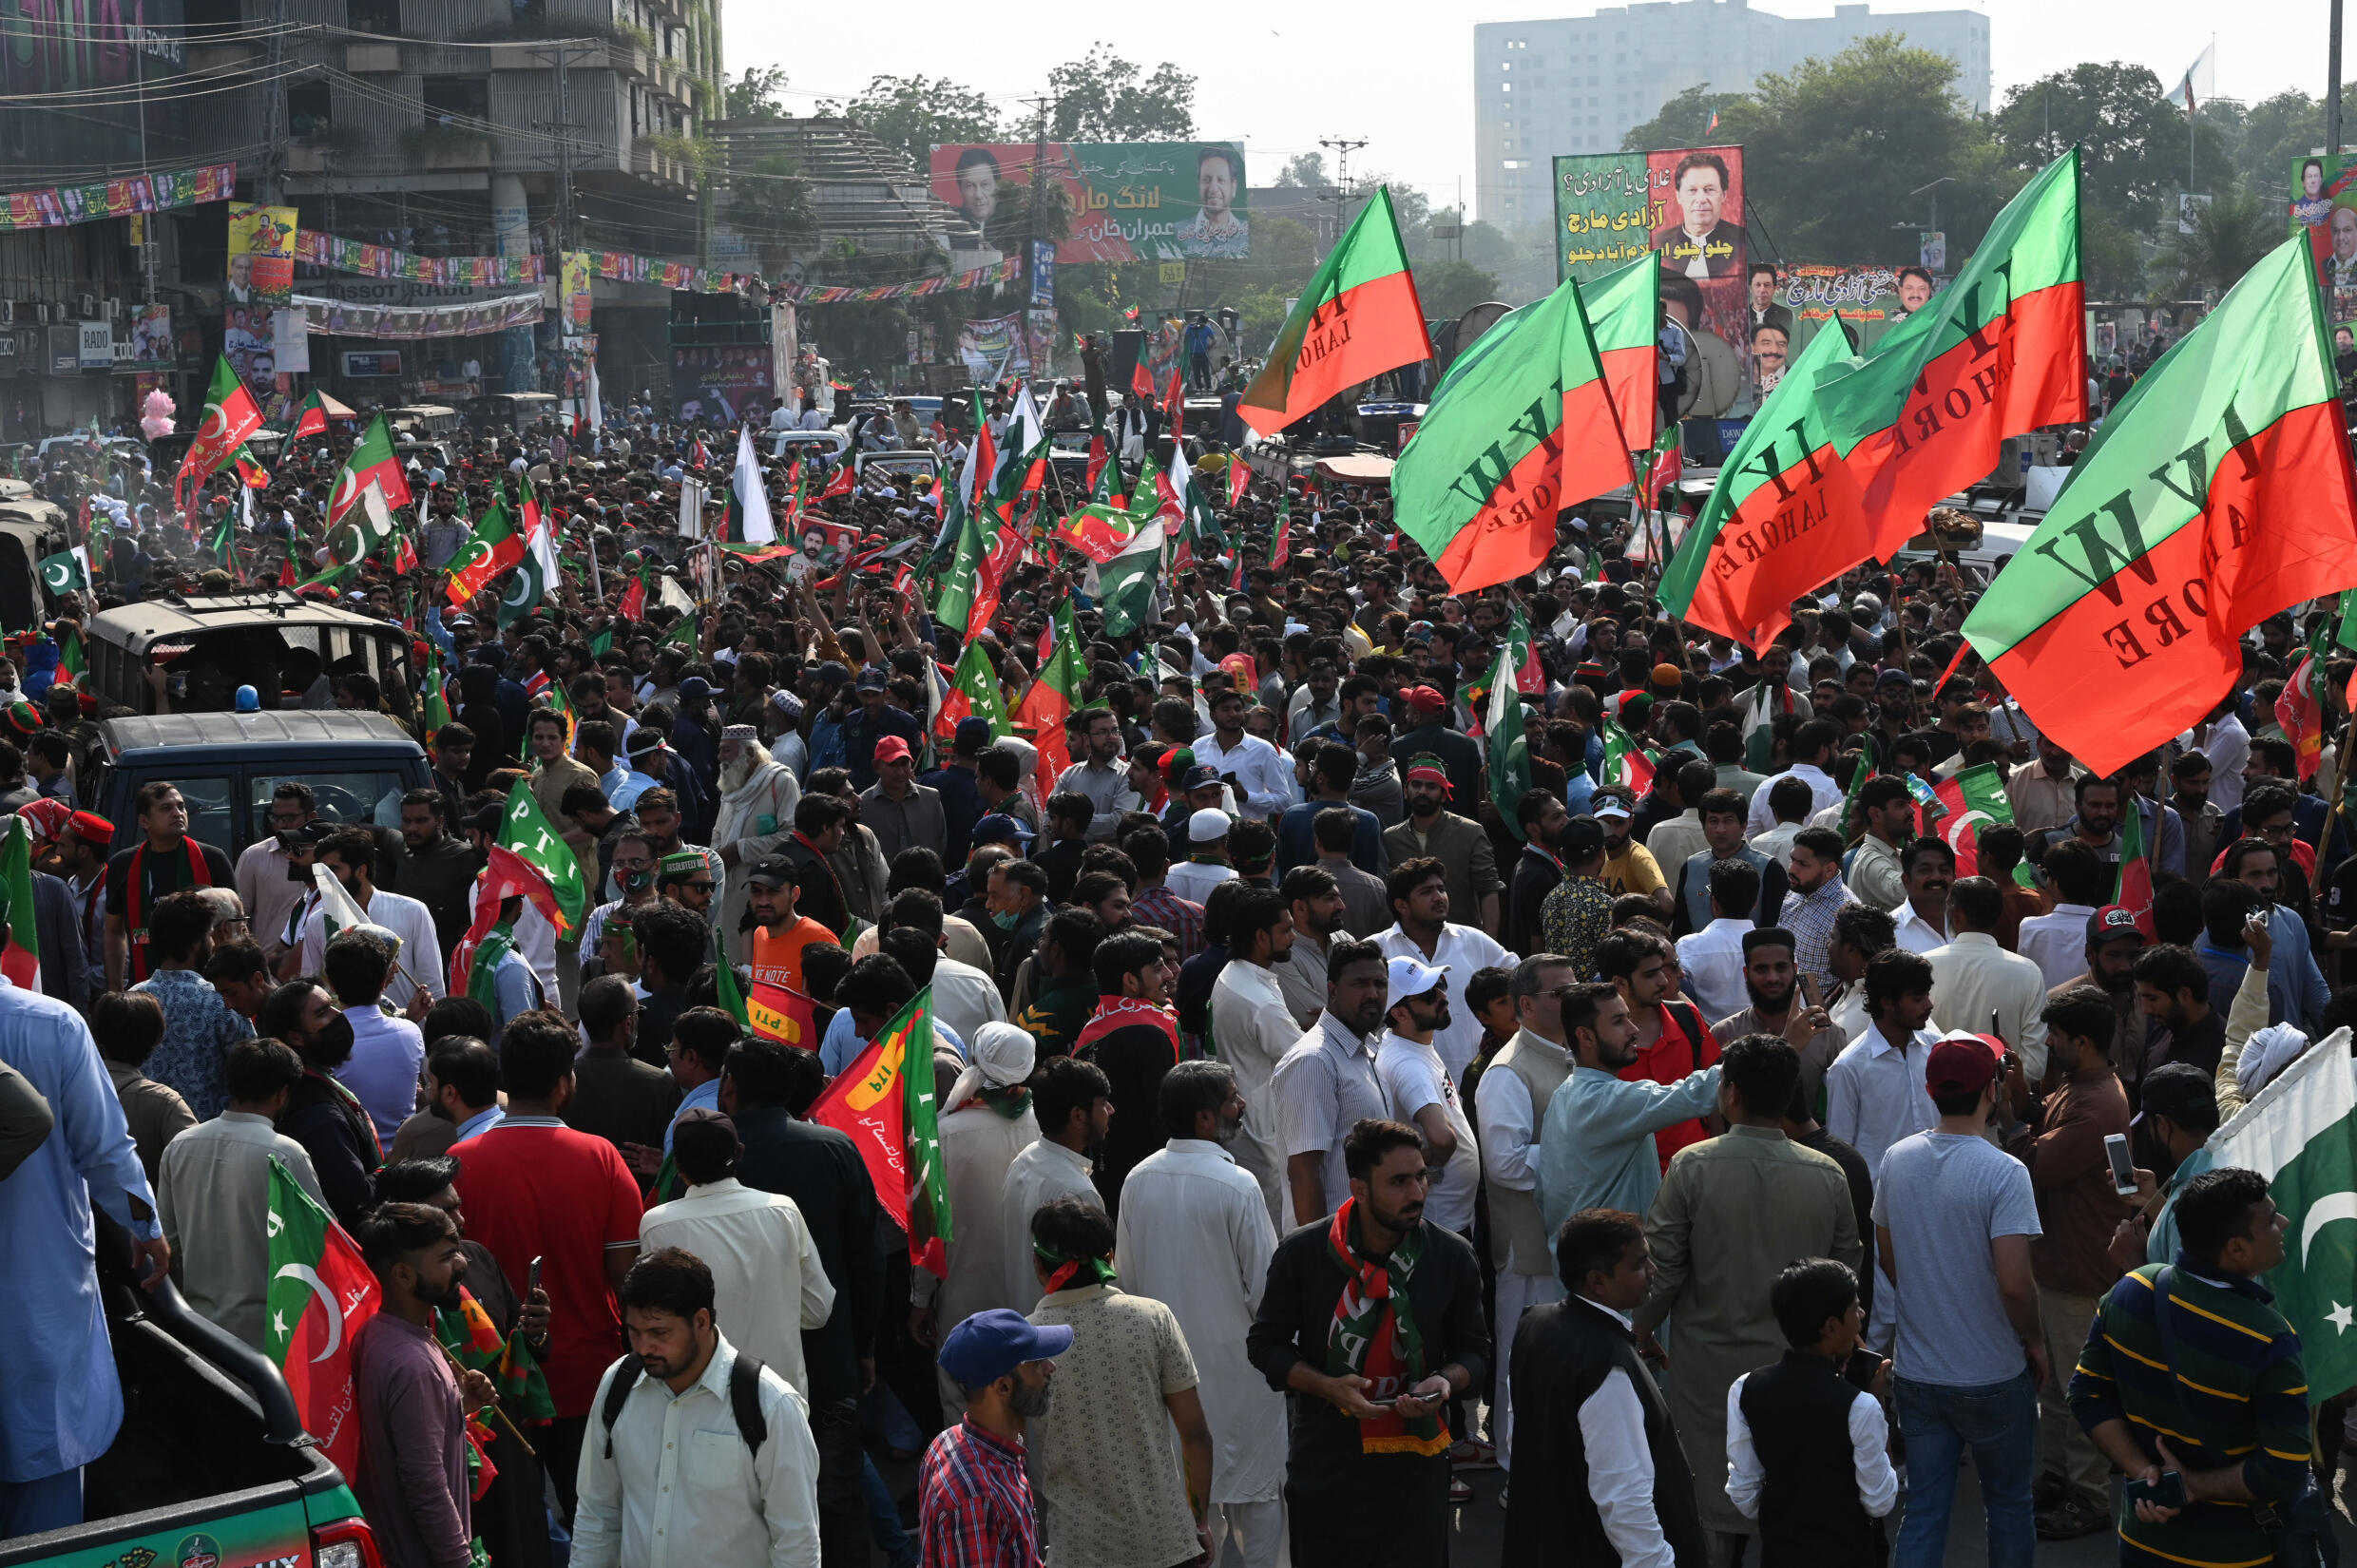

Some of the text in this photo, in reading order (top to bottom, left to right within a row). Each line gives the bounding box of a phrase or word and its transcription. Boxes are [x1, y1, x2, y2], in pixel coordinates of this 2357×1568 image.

[146, 29, 169, 60] ZONG
[1113, 184, 1161, 209] لانگ
[1567, 200, 1667, 234] آزادی مارچ
[1088, 219, 1121, 242] خان
[1122, 219, 1175, 241] عمران
[1567, 246, 1597, 266] چلو
[1626, 241, 1670, 261] الام
[1673, 241, 1701, 261] چلو
[1704, 239, 1734, 259] چلو
[1821, 267, 1836, 276] 28
[1786, 276, 1823, 307] مارچ
[0, 338, 14, 356] IKO
[84, 331, 107, 349] RADO
[1722, 429, 1744, 438] DAW
[510, 798, 577, 880] PTI
[666, 859, 697, 872] ABSOLUTELY
[764, 969, 792, 983] NOTE
[755, 1009, 781, 1029] PTI
